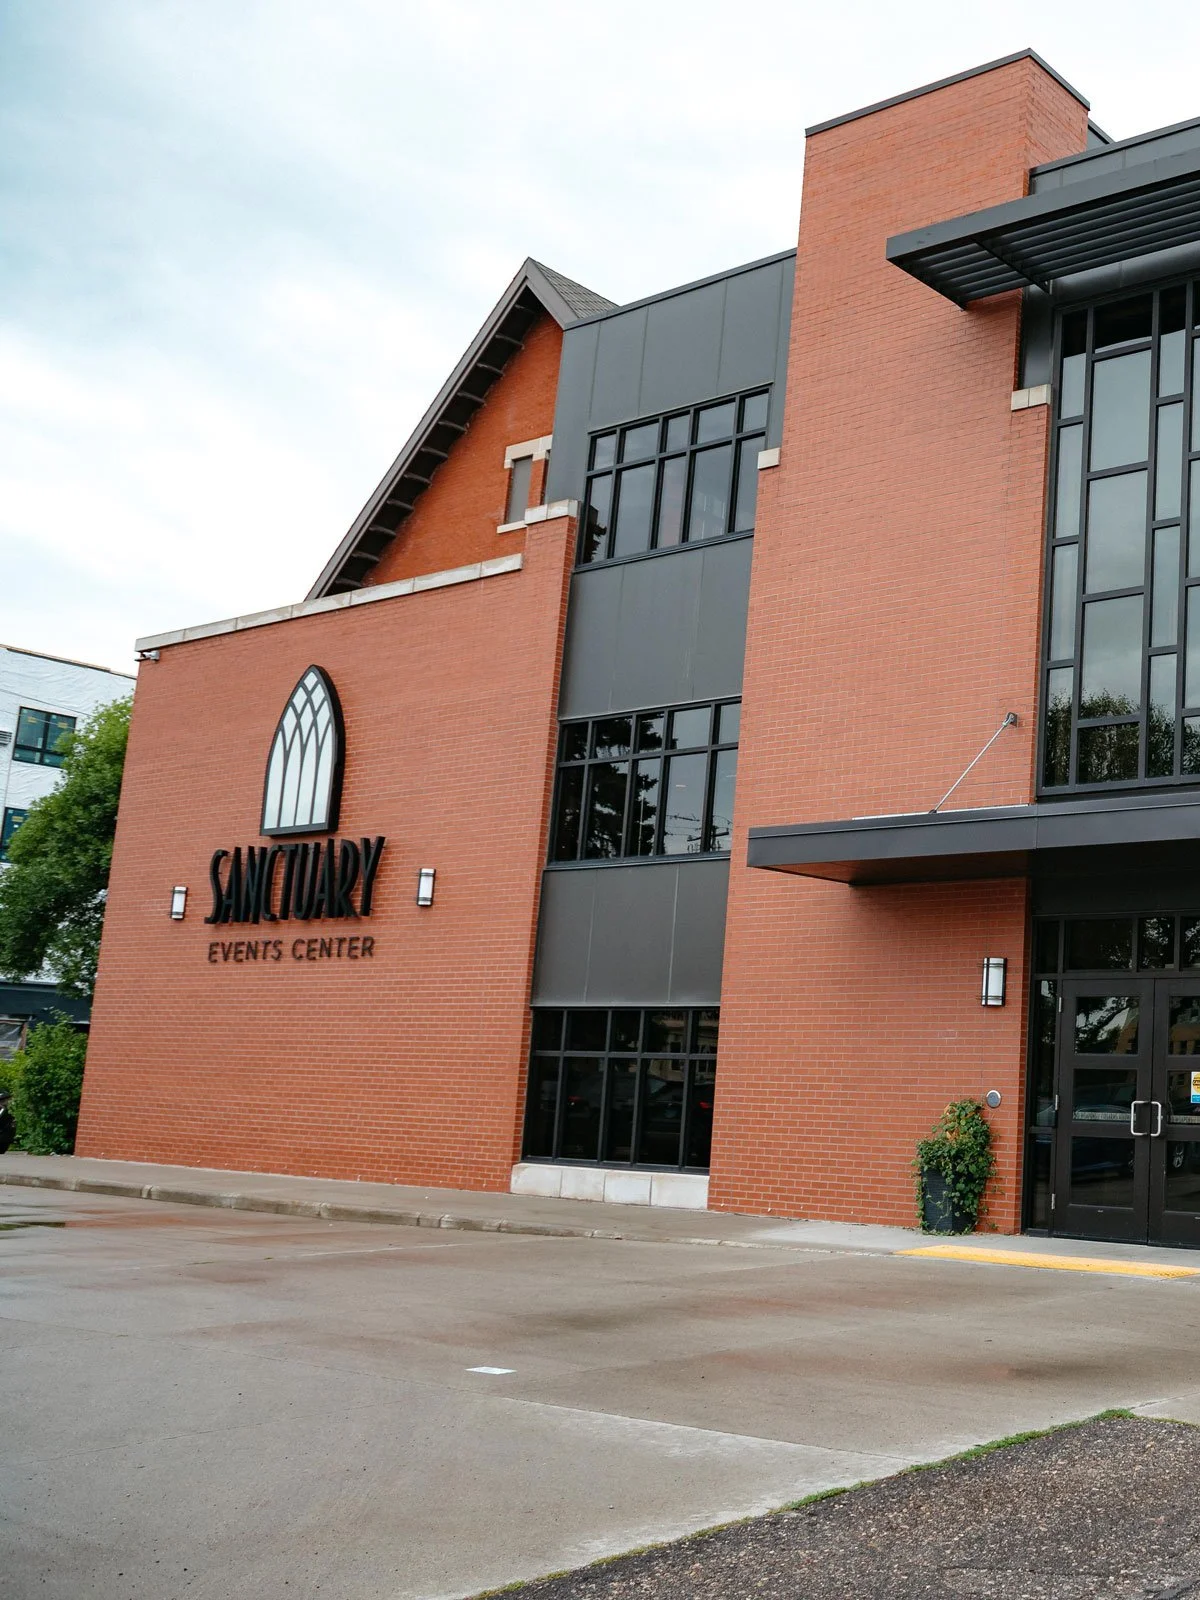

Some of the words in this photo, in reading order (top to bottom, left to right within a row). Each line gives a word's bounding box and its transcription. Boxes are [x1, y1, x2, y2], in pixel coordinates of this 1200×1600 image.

[204, 836, 386, 925] SANCTUARY
[208, 940, 283, 963] EVENTS
[292, 936, 376, 961] CENTER
